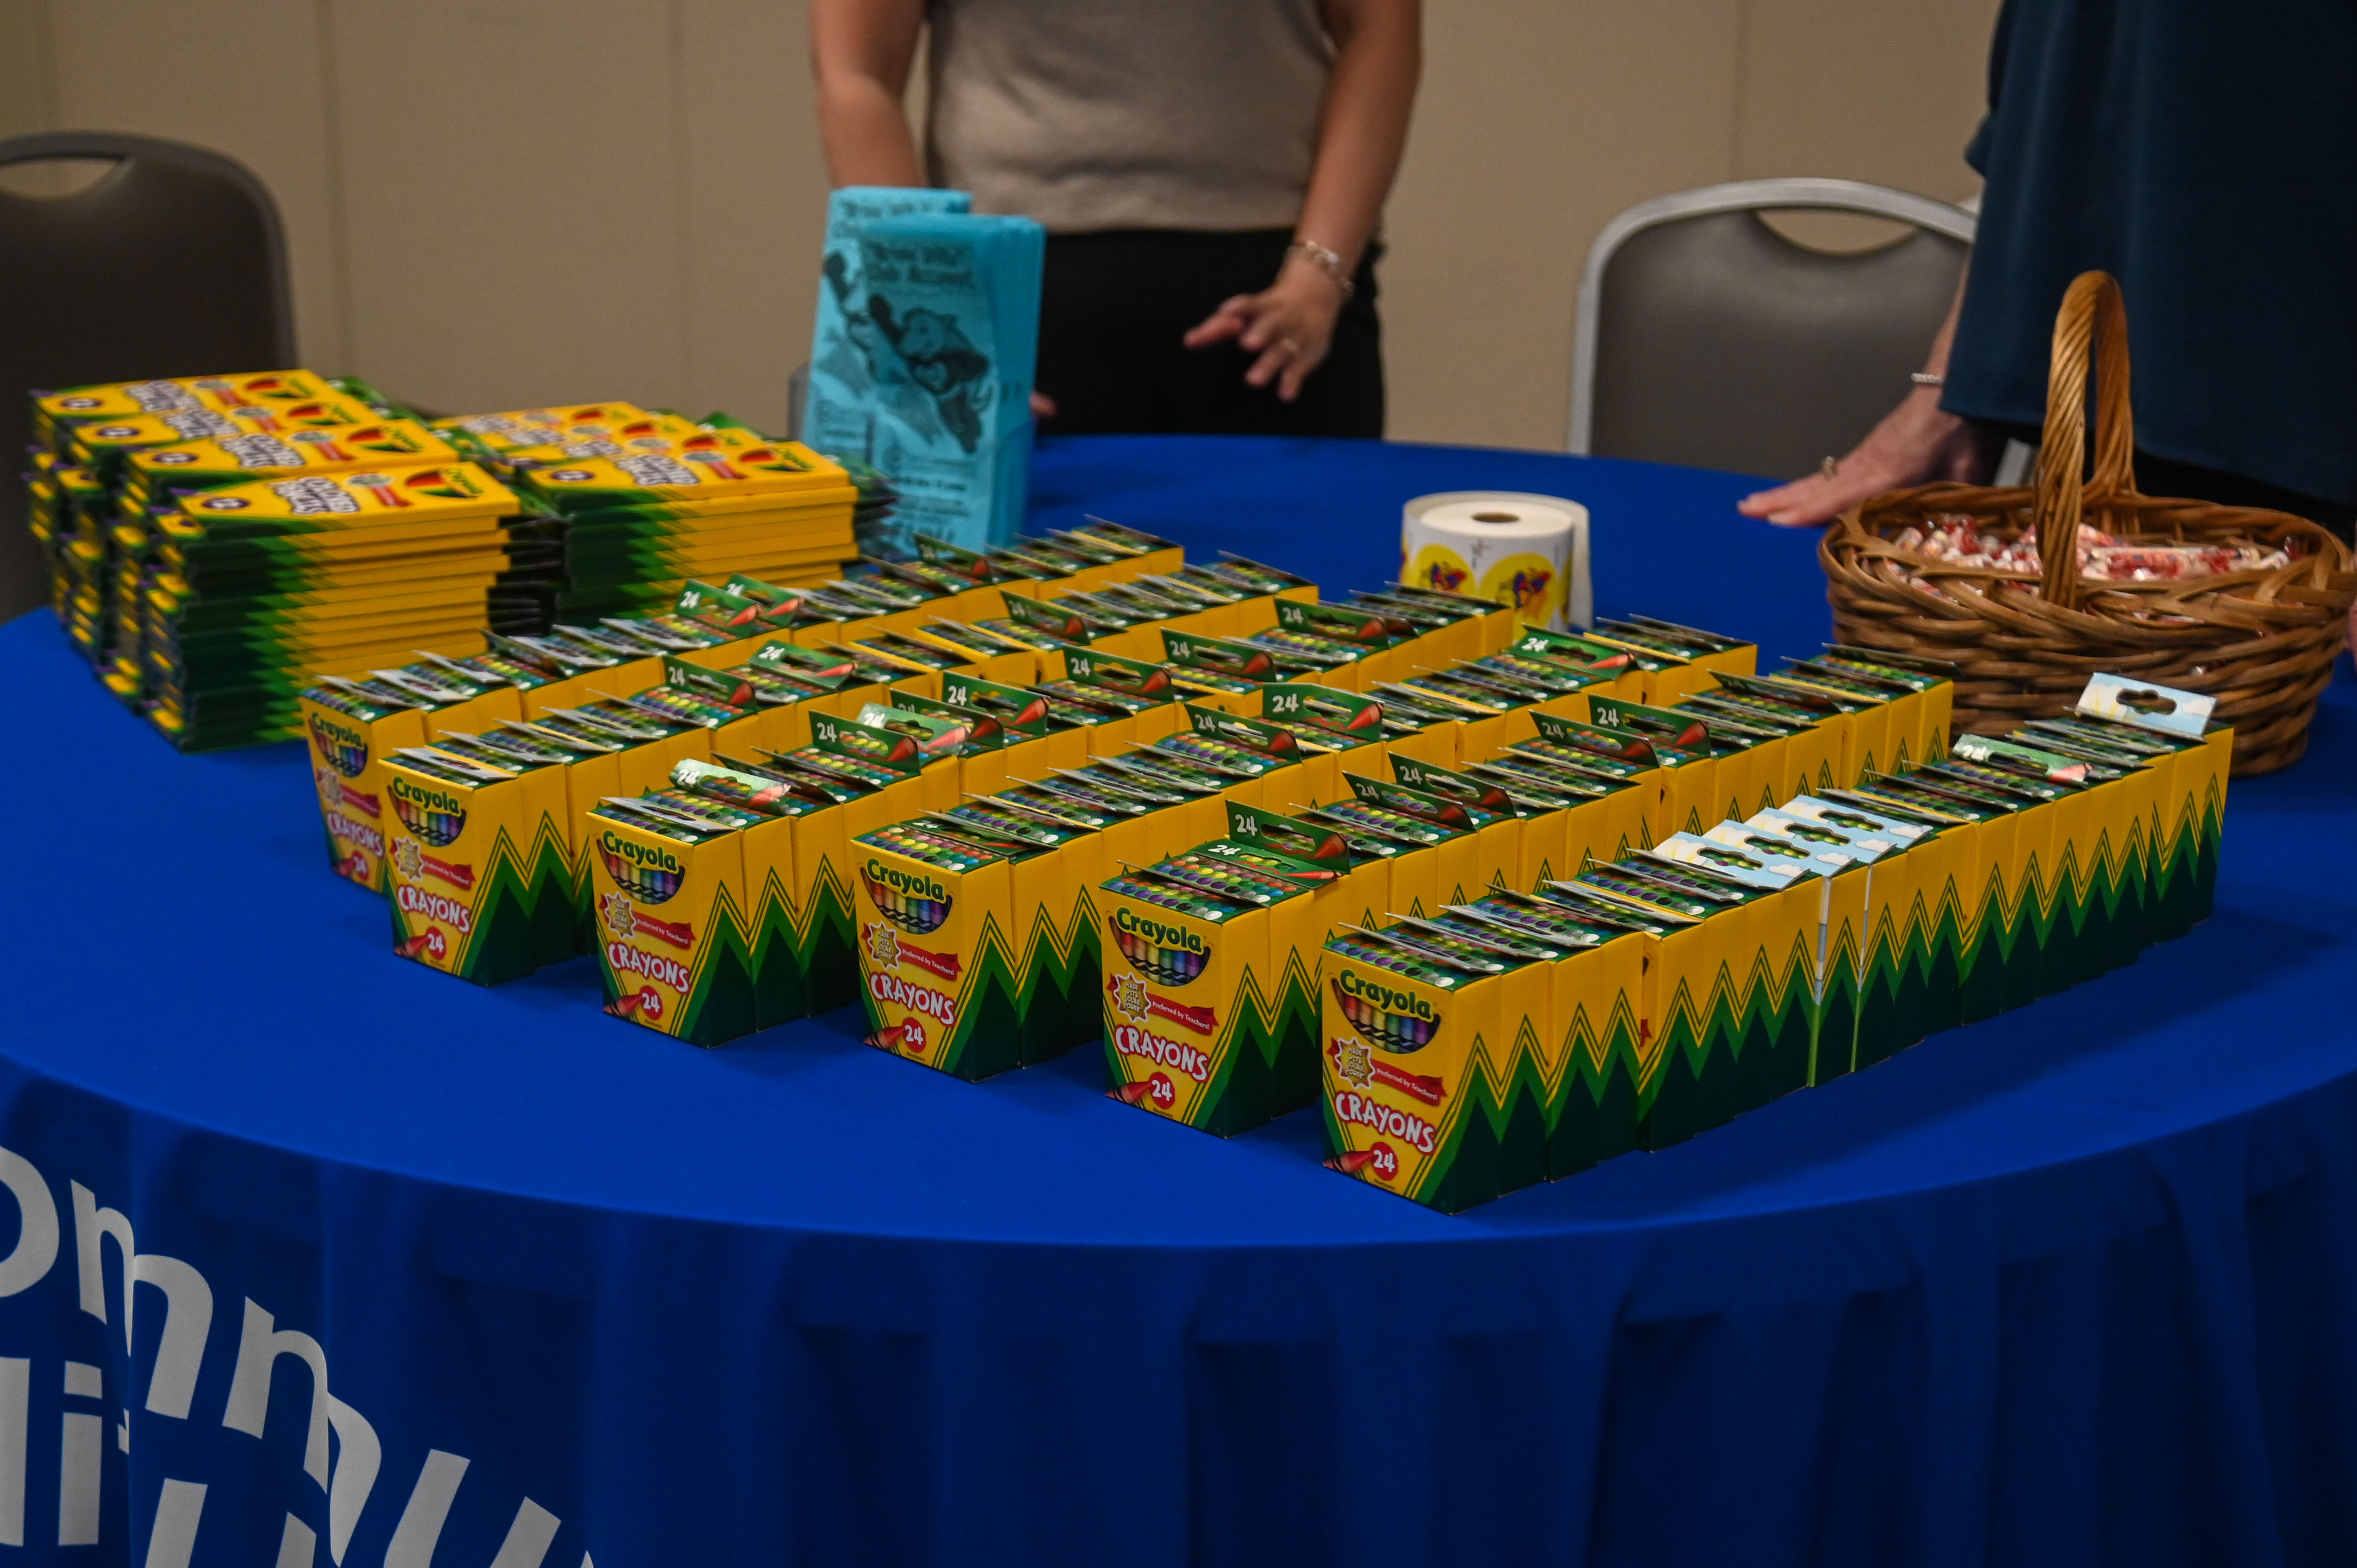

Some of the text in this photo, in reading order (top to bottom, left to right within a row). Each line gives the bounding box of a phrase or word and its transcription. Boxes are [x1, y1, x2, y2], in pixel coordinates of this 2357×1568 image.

[680, 590, 701, 609] 24
[1282, 607, 1304, 624] 24
[758, 647, 785, 661] 24
[1170, 640, 1190, 658] 24
[1521, 637, 1549, 652] 24
[669, 666, 686, 686] 24
[1071, 657, 1090, 676] 24
[948, 685, 967, 706] 24
[1272, 693, 1299, 712] 24
[864, 712, 886, 727] 24
[1194, 714, 1215, 732] 24
[1597, 707, 1620, 727] 24
[312, 711, 363, 747] Crayola
[816, 722, 837, 742] 24
[1541, 722, 1565, 738] 24
[676, 768, 700, 785] 24
[1402, 765, 1422, 785] 24
[393, 777, 459, 813] Crayola
[1356, 783, 1380, 800] 24
[326, 812, 383, 857] CRAYONS
[1235, 814, 1258, 835] 24
[603, 831, 677, 871] Crayola
[1208, 844, 1238, 856] 24
[867, 859, 944, 900] Crayola
[397, 885, 470, 933] CRAYONS
[1117, 907, 1202, 952] Crayola
[427, 933, 445, 953] 24
[609, 943, 689, 993] CRAYONS
[902, 949, 955, 976] Preferred by Teachers!
[642, 993, 661, 1013] 24
[871, 973, 954, 1025] CRAYONS
[1340, 970, 1432, 1019] Crayola
[1152, 1001, 1210, 1030] Preferred by Teachers!
[905, 1024, 924, 1046] 24
[1115, 1027, 1208, 1081] CRAYONS
[1152, 1080, 1172, 1102] 24
[1376, 1068, 1438, 1101] Preferred by Teachers!
[1335, 1092, 1434, 1152] CRAYONS
[1374, 1149, 1395, 1173] 24
